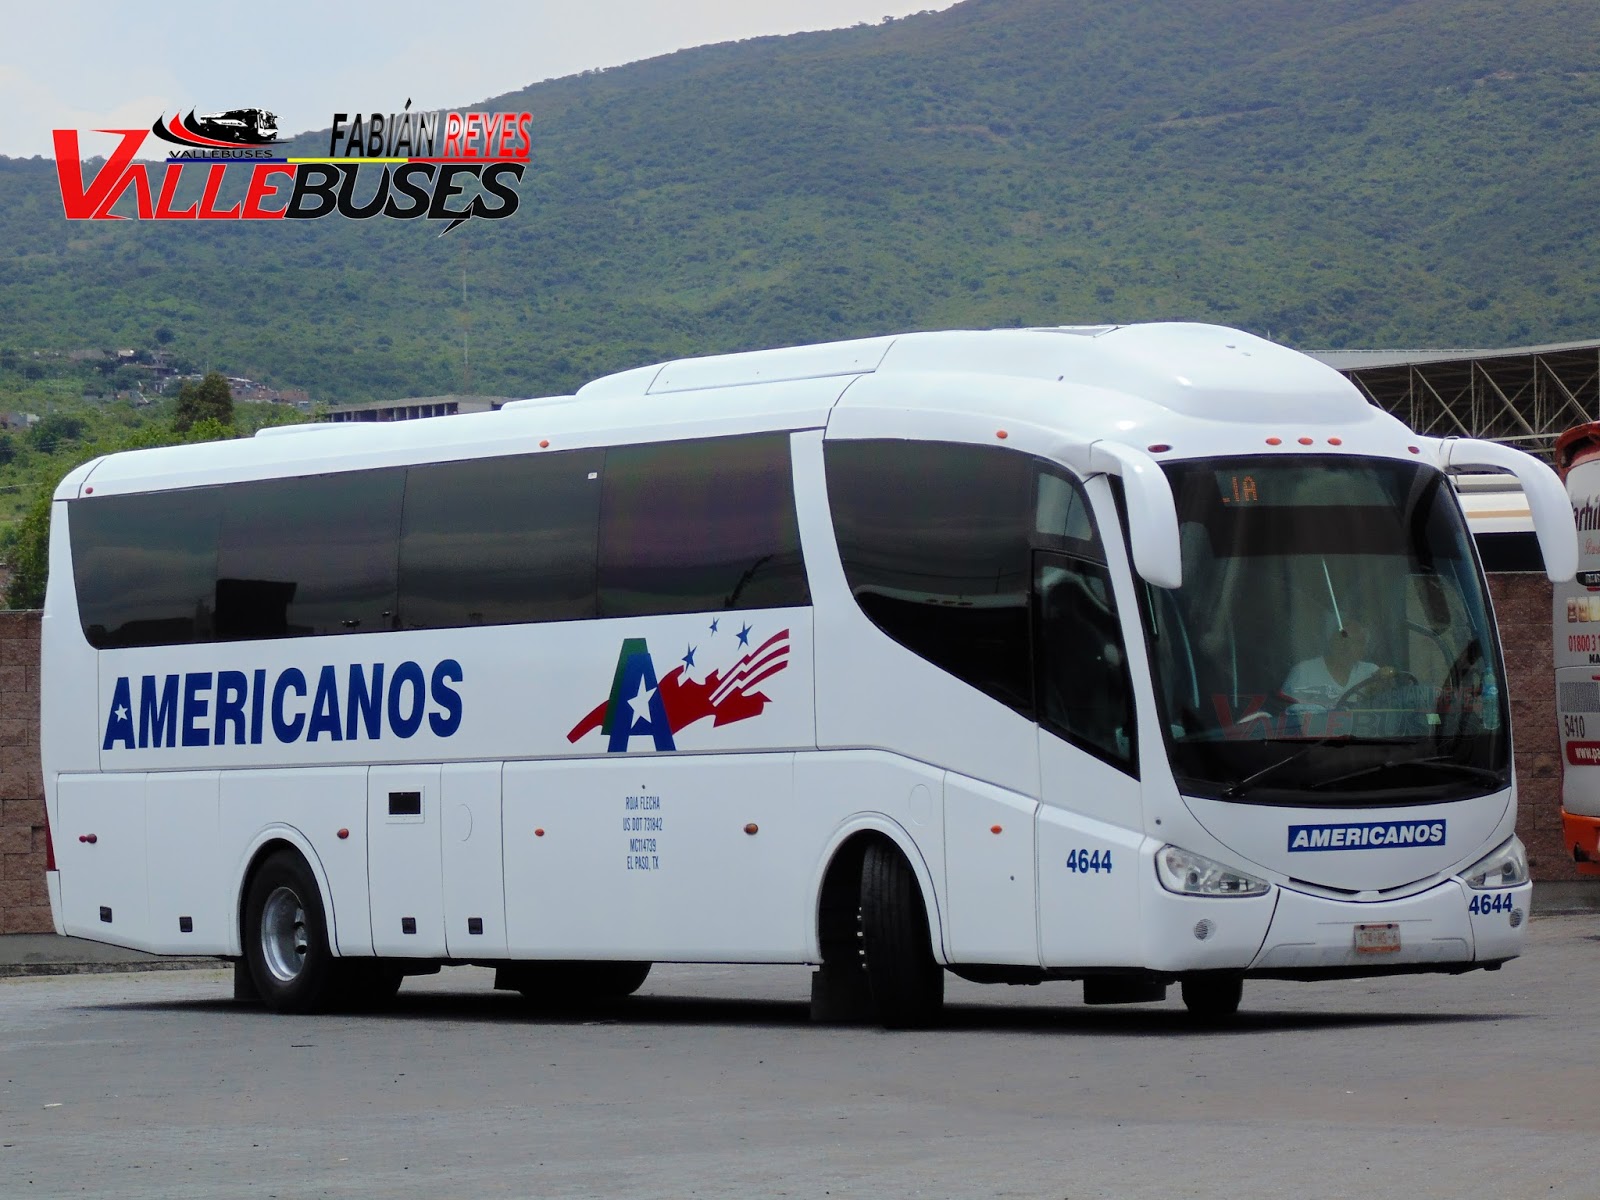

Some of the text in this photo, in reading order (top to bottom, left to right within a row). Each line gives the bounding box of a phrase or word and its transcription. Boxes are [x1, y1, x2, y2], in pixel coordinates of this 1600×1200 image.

[1568, 634, 1590, 652] 01800
[102, 658, 463, 750] AMERICANOS
[1564, 715, 1585, 738] 5410
[640, 796, 660, 810] FLECHA
[623, 817, 630, 831] US
[632, 817, 642, 831] DOT
[1291, 823, 1444, 849] AMERICANOS
[627, 855, 659, 871] EL PASO, TX
[1066, 848, 1112, 874] 4644
[1468, 892, 1513, 915] 4644
